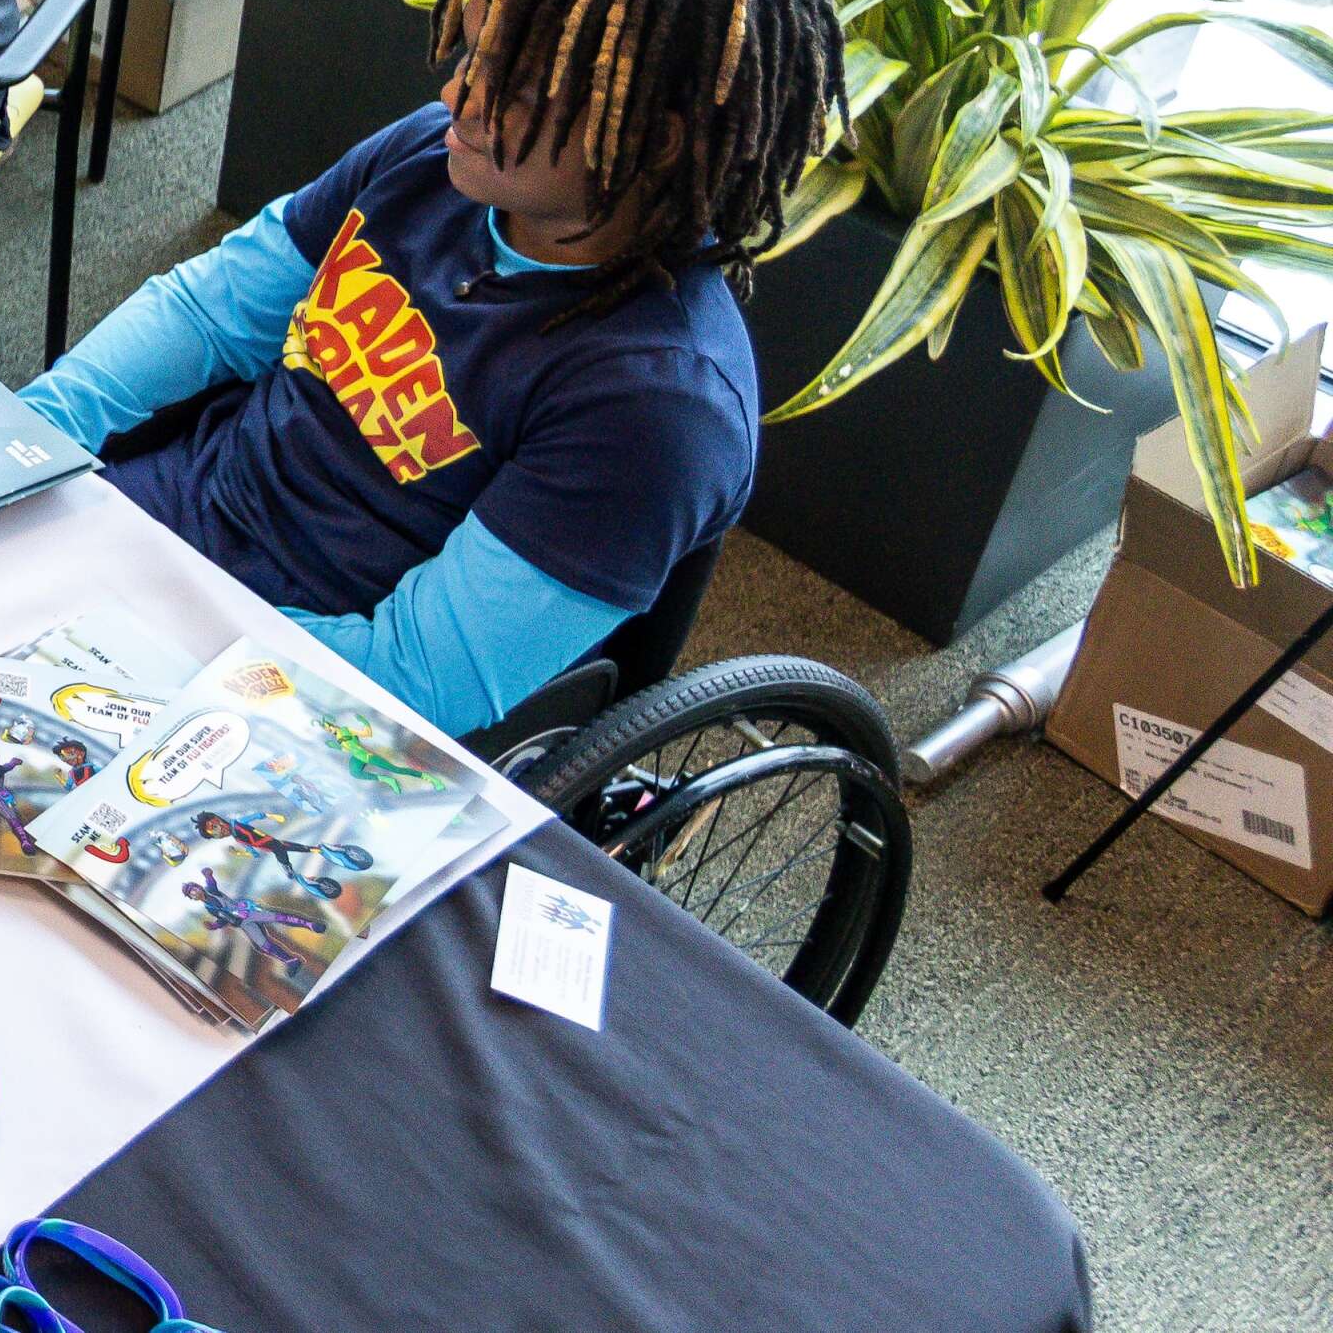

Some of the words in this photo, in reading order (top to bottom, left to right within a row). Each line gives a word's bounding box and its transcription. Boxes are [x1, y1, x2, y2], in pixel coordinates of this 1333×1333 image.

[308, 210, 480, 467] KADEN
[87, 706, 113, 718] TEAM
[117, 712, 129, 721] OF
[132, 716, 150, 726] FLU
[105, 701, 127, 713] JOIN
[131, 707, 151, 717] OUR
[1116, 712, 1194, 746] C103507
[163, 755, 177, 769] JOIN
[176, 742, 191, 758] OUR
[190, 725, 213, 745] SUPER
[159, 769, 180, 785] TEAM
[178, 759, 189, 770] OF
[71, 824, 91, 844] SCAN
[88, 830, 102, 843] ME
